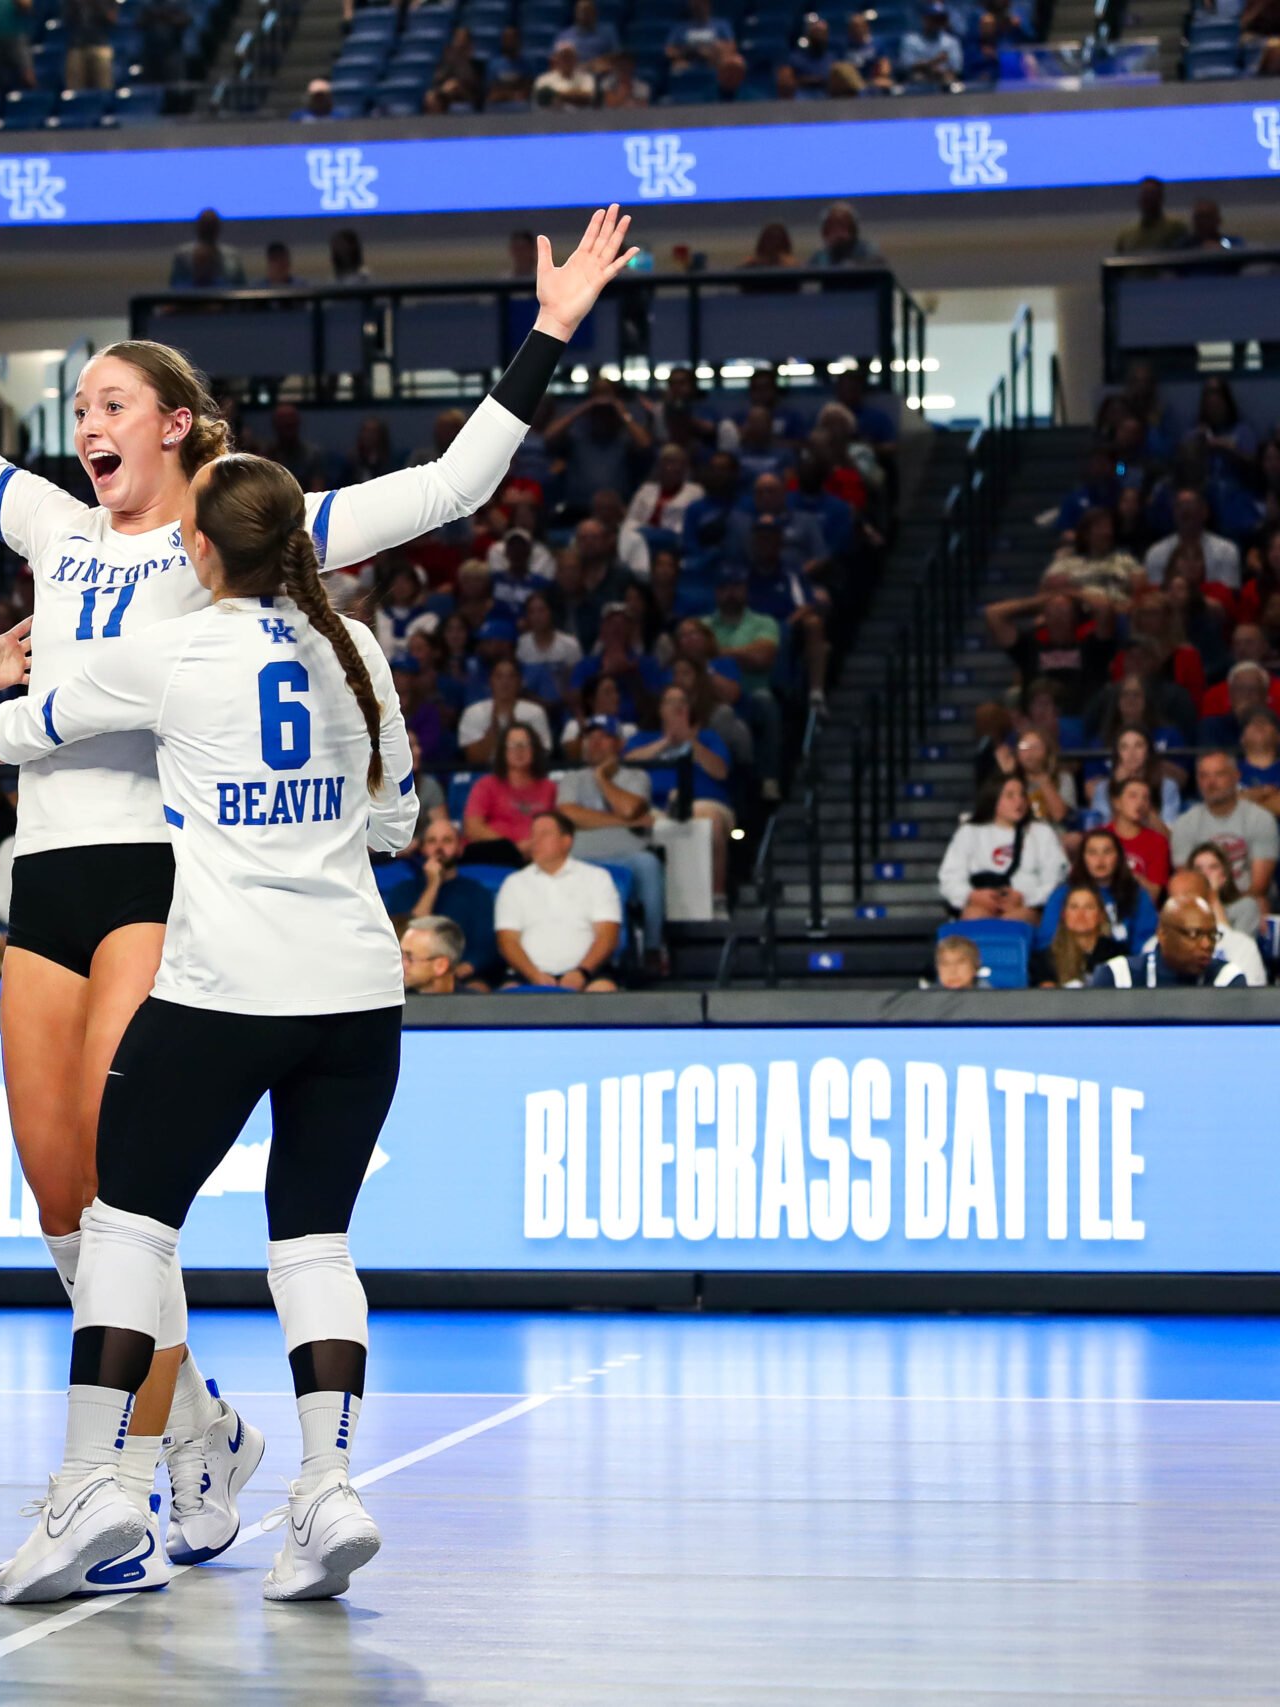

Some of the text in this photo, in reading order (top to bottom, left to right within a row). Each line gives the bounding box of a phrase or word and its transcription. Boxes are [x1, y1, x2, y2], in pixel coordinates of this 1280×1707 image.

[306, 148, 378, 210] UK
[623, 135, 697, 198] UK
[935, 121, 1008, 186] UK
[76, 583, 136, 640] 17
[258, 618, 297, 643] UK
[258, 661, 311, 771] 6
[217, 776, 345, 825] BEAVIN
[524, 1057, 1146, 1241] BLUEGRASS BATTLE
